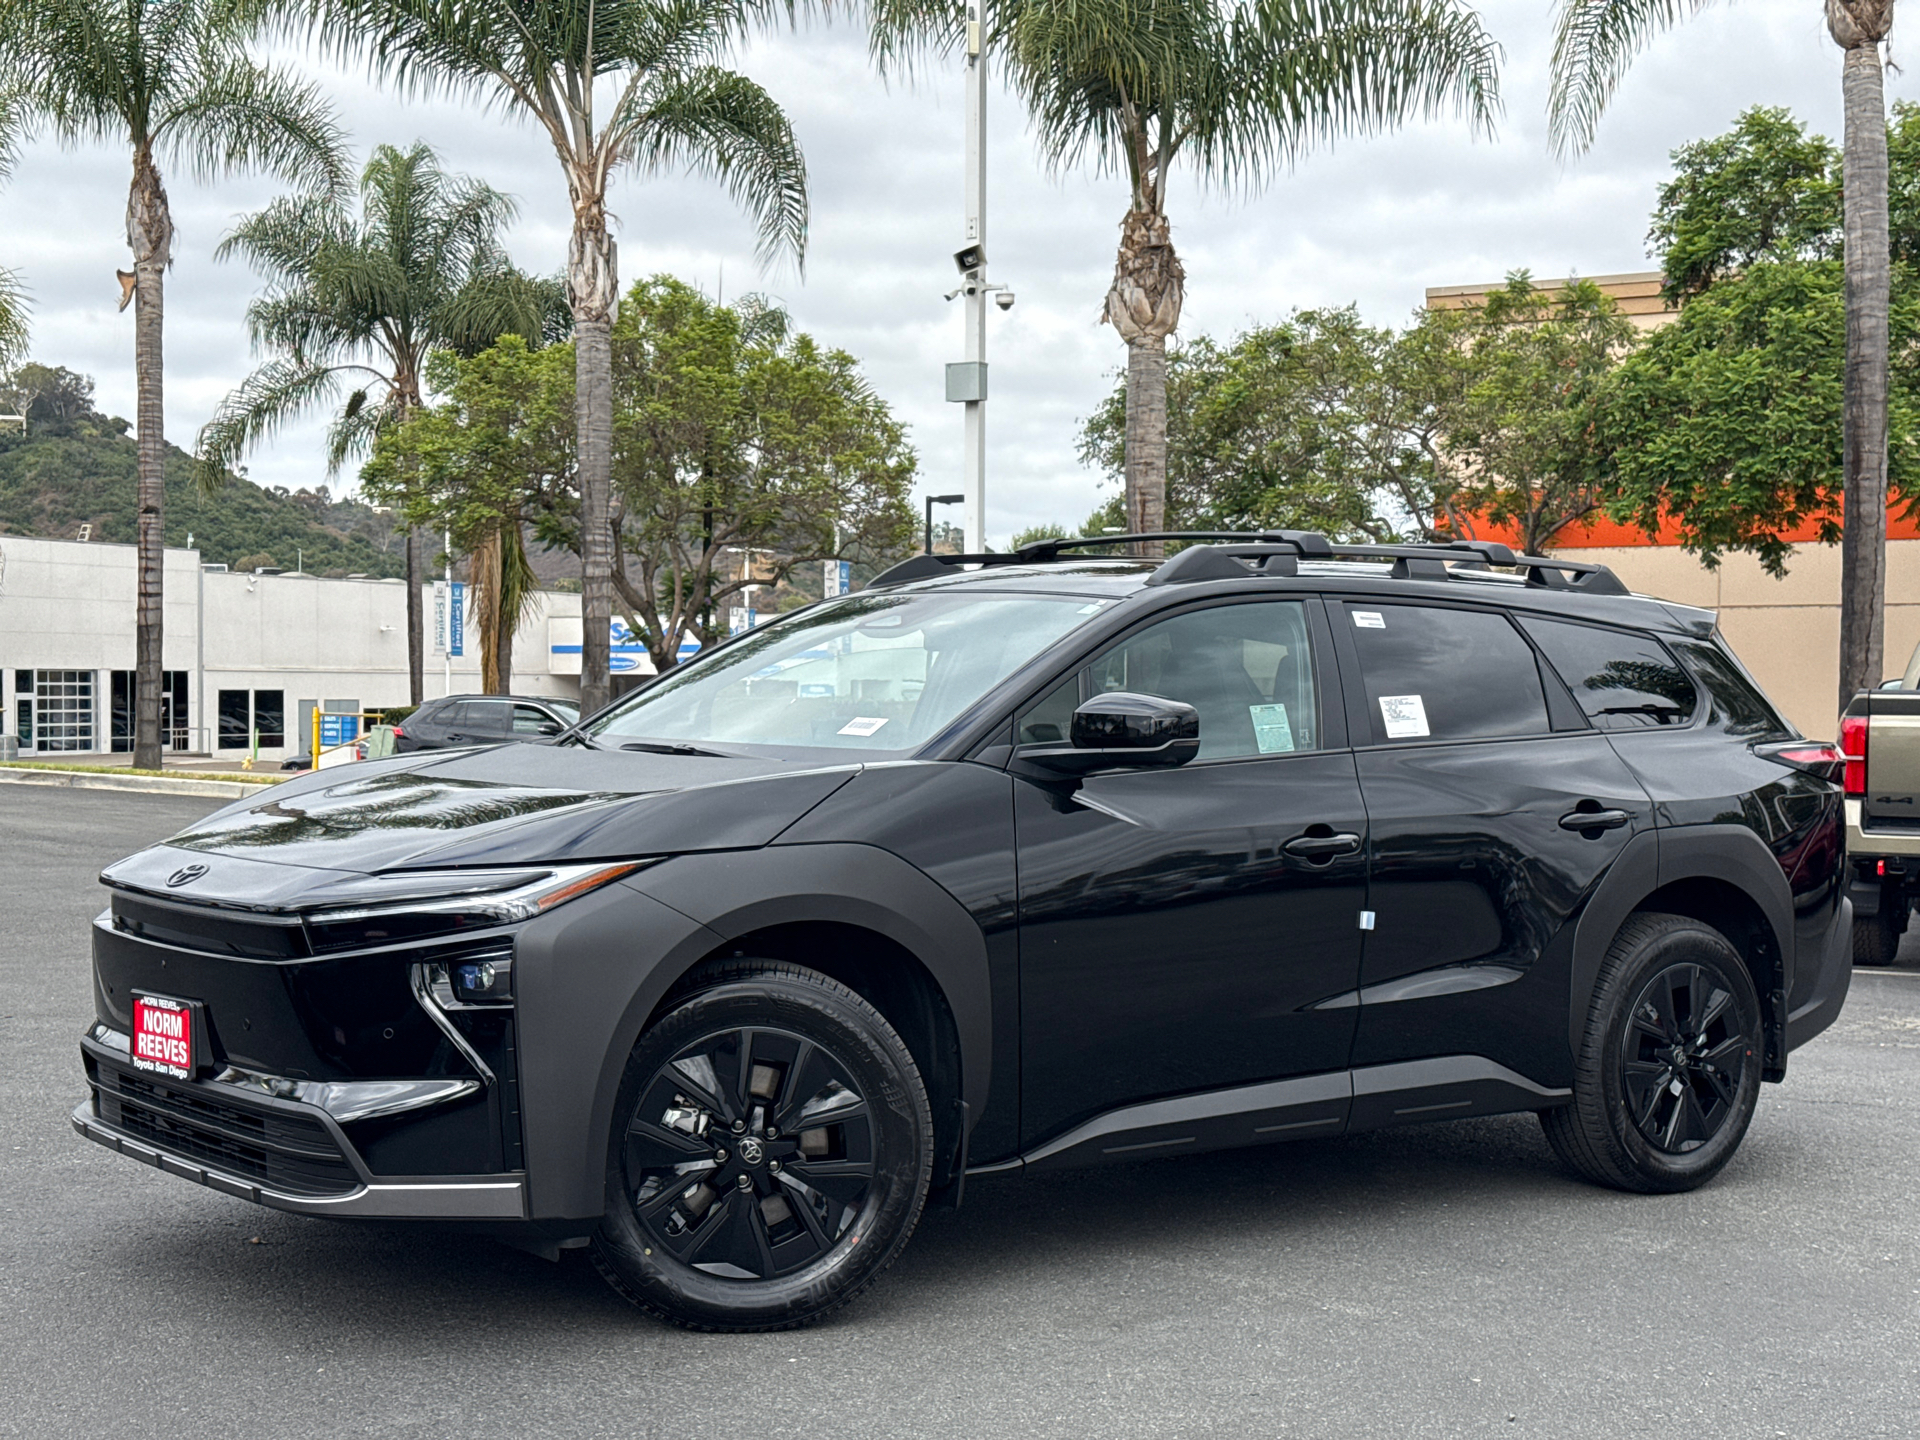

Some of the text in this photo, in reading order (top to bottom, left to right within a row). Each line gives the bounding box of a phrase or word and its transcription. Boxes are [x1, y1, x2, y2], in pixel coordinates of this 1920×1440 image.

[143, 996, 177, 1011] NORM REEVES
[143, 1009, 182, 1038] NORM
[138, 1032, 187, 1064] REEVES
[132, 1056, 188, 1080] Toyota San Diego
